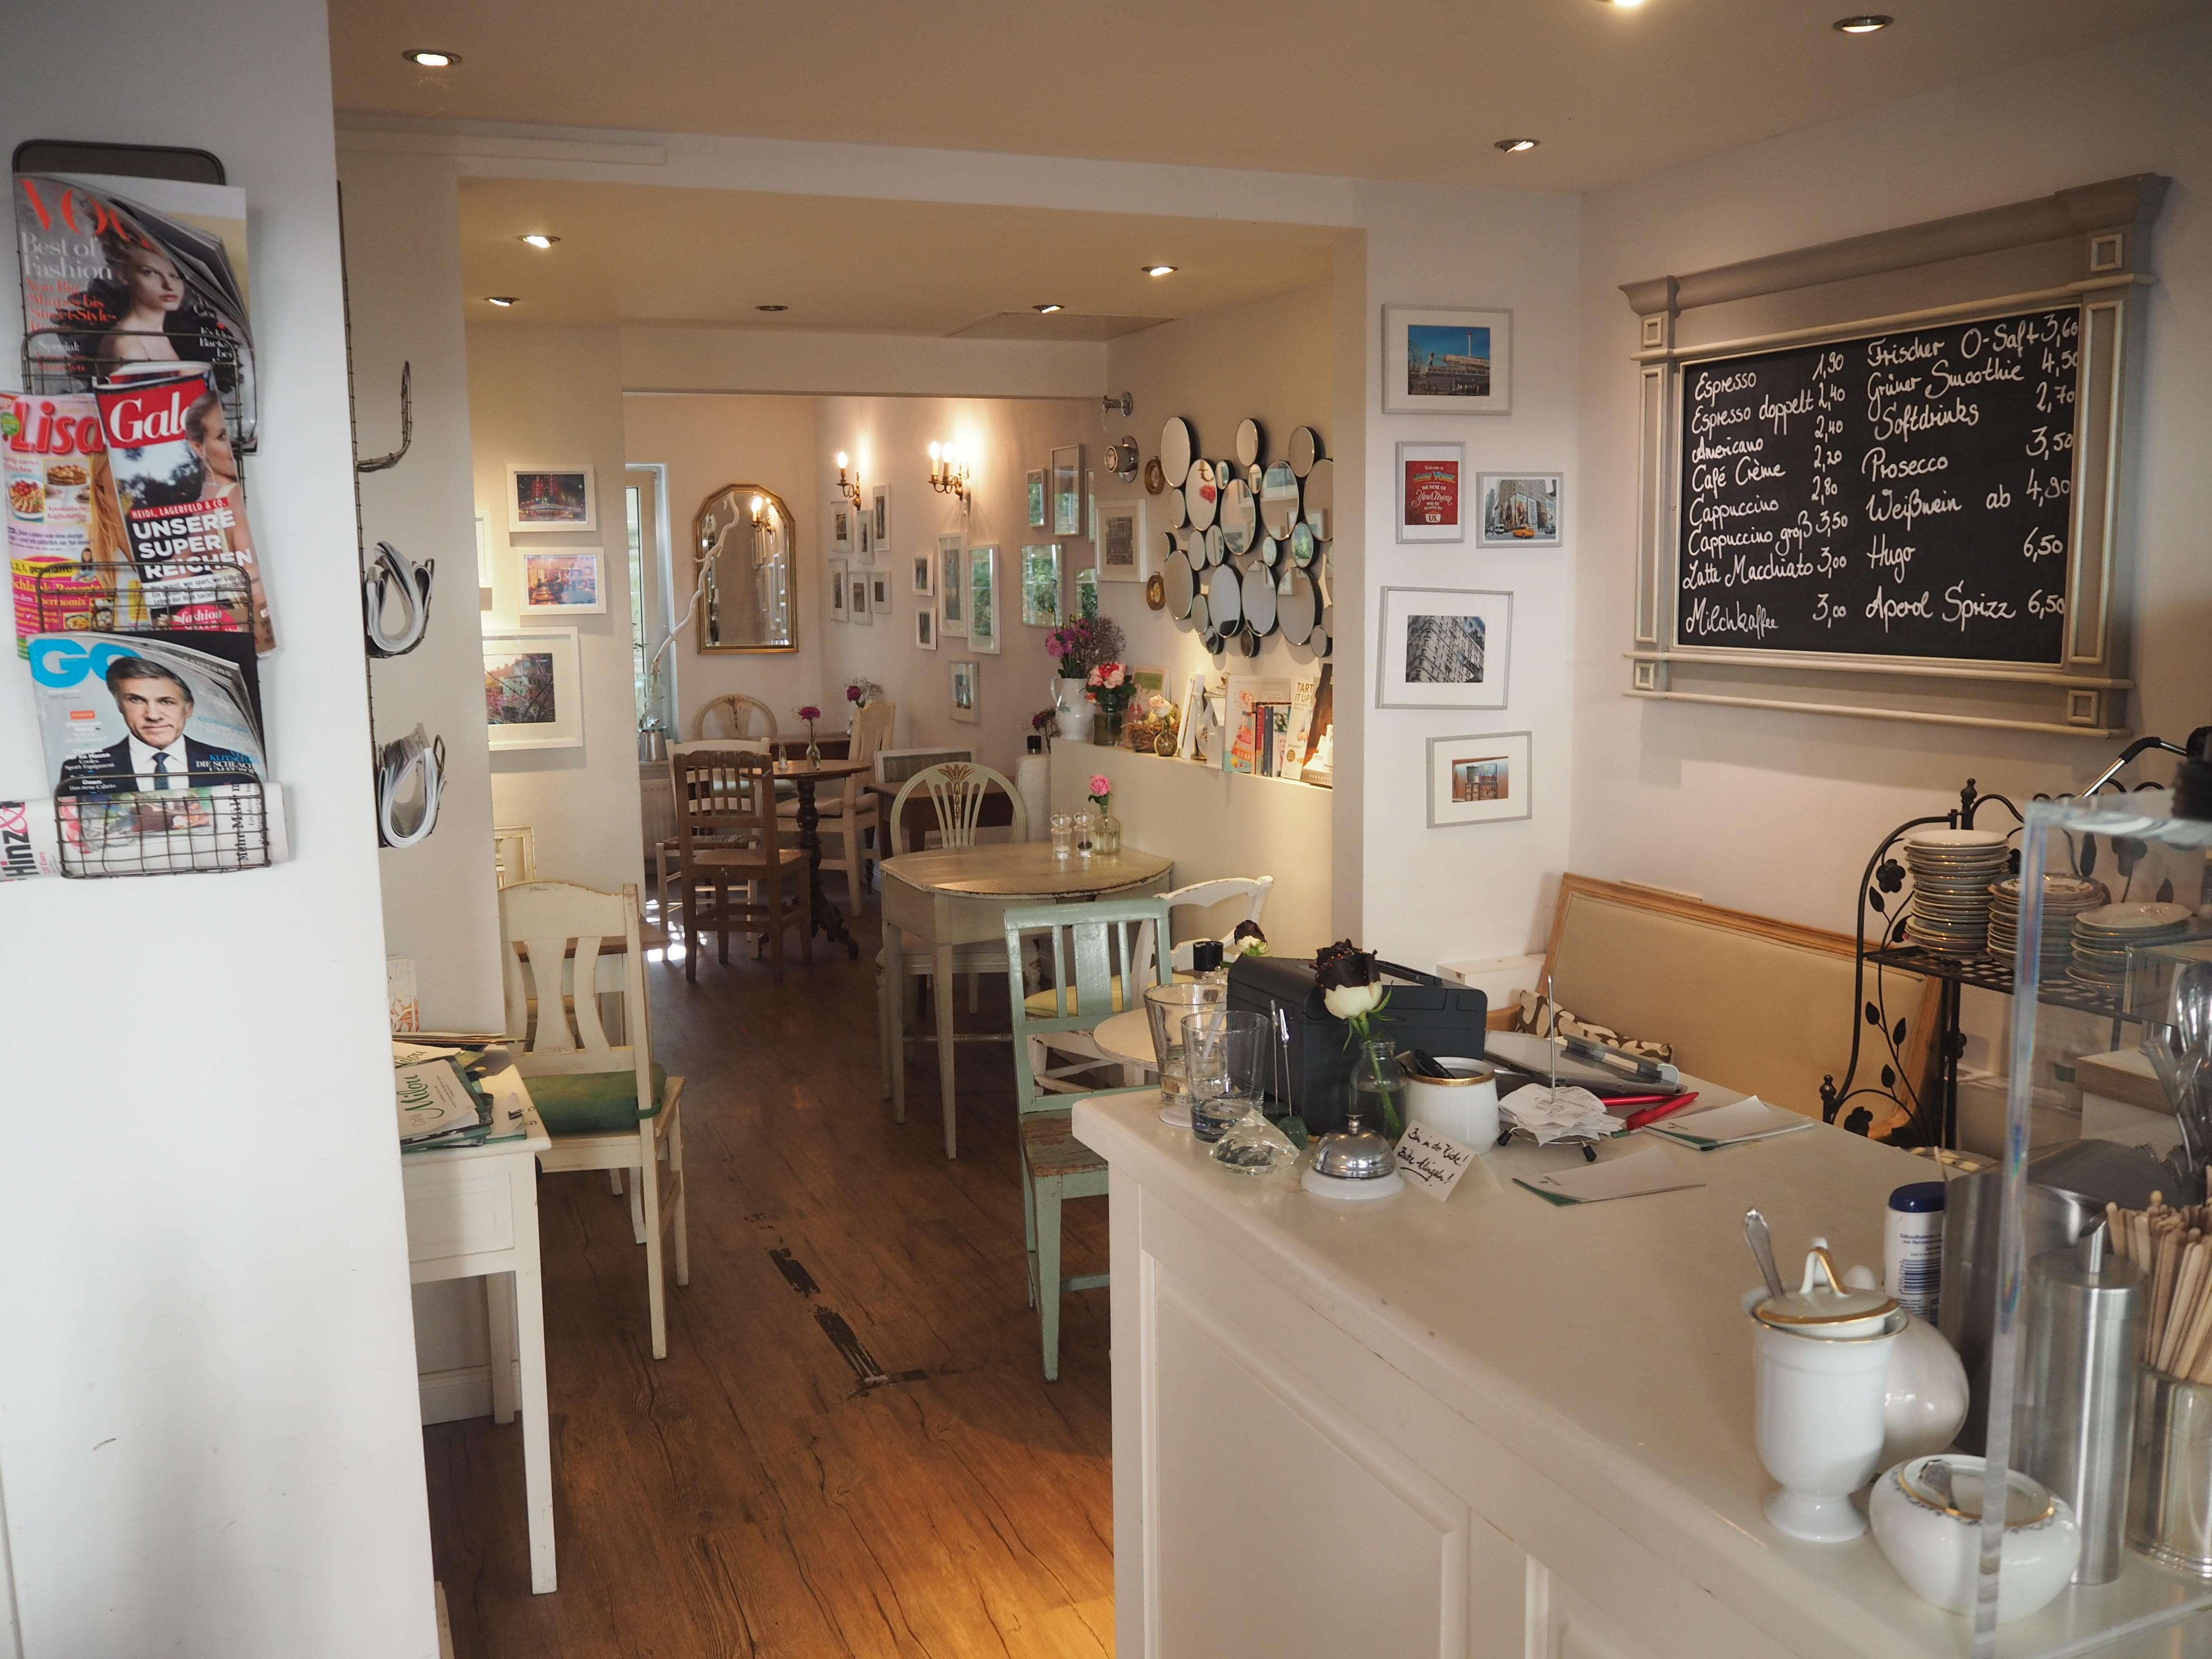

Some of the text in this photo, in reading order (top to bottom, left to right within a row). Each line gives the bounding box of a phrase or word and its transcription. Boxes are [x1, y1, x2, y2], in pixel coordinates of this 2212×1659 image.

[20, 231, 100, 258] Best of
[22, 253, 113, 281] Fashion
[1867, 336, 1945, 367] Frischer
[1960, 319, 2040, 360] O-Saft
[1695, 351, 1844, 408] Espresso 1,90
[1867, 347, 2078, 422] Grüner Smoothie 4,50
[10, 400, 108, 455] Lisa
[1691, 381, 1846, 441] Espresso doppelt 2,40
[1874, 381, 2075, 443] Softdrinks 2,70
[1691, 415, 1844, 464] Americano 2,40
[1861, 425, 2073, 482] Prosecco 3,50
[1692, 444, 1842, 500] Café Crème 2,20
[159, 502, 205, 517] LAGERFELD
[205, 501, 212, 510] &
[1689, 475, 1838, 530] Cappuccino 2,80
[1865, 467, 2071, 532] Weißwein ab 4,90
[132, 509, 237, 540] UNSERE
[138, 534, 223, 559] SUPER
[1688, 510, 1849, 559] Cappuccino groß 3,50
[1682, 546, 1847, 590] Latte Macchiato 3,00
[1866, 526, 2063, 584] Hugo 6,50
[34, 594, 86, 606] Termomix
[180, 608, 223, 625] fashion
[1685, 593, 1847, 641] Milchkaffee 3,00
[1865, 584, 1934, 634] Aperol
[2028, 589, 2065, 620] 6,50
[1295, 693, 1313, 703] IT UP!
[1297, 682, 1314, 694] TART
[393, 1050, 427, 1065] ilou
[397, 1073, 445, 1119] Milou
